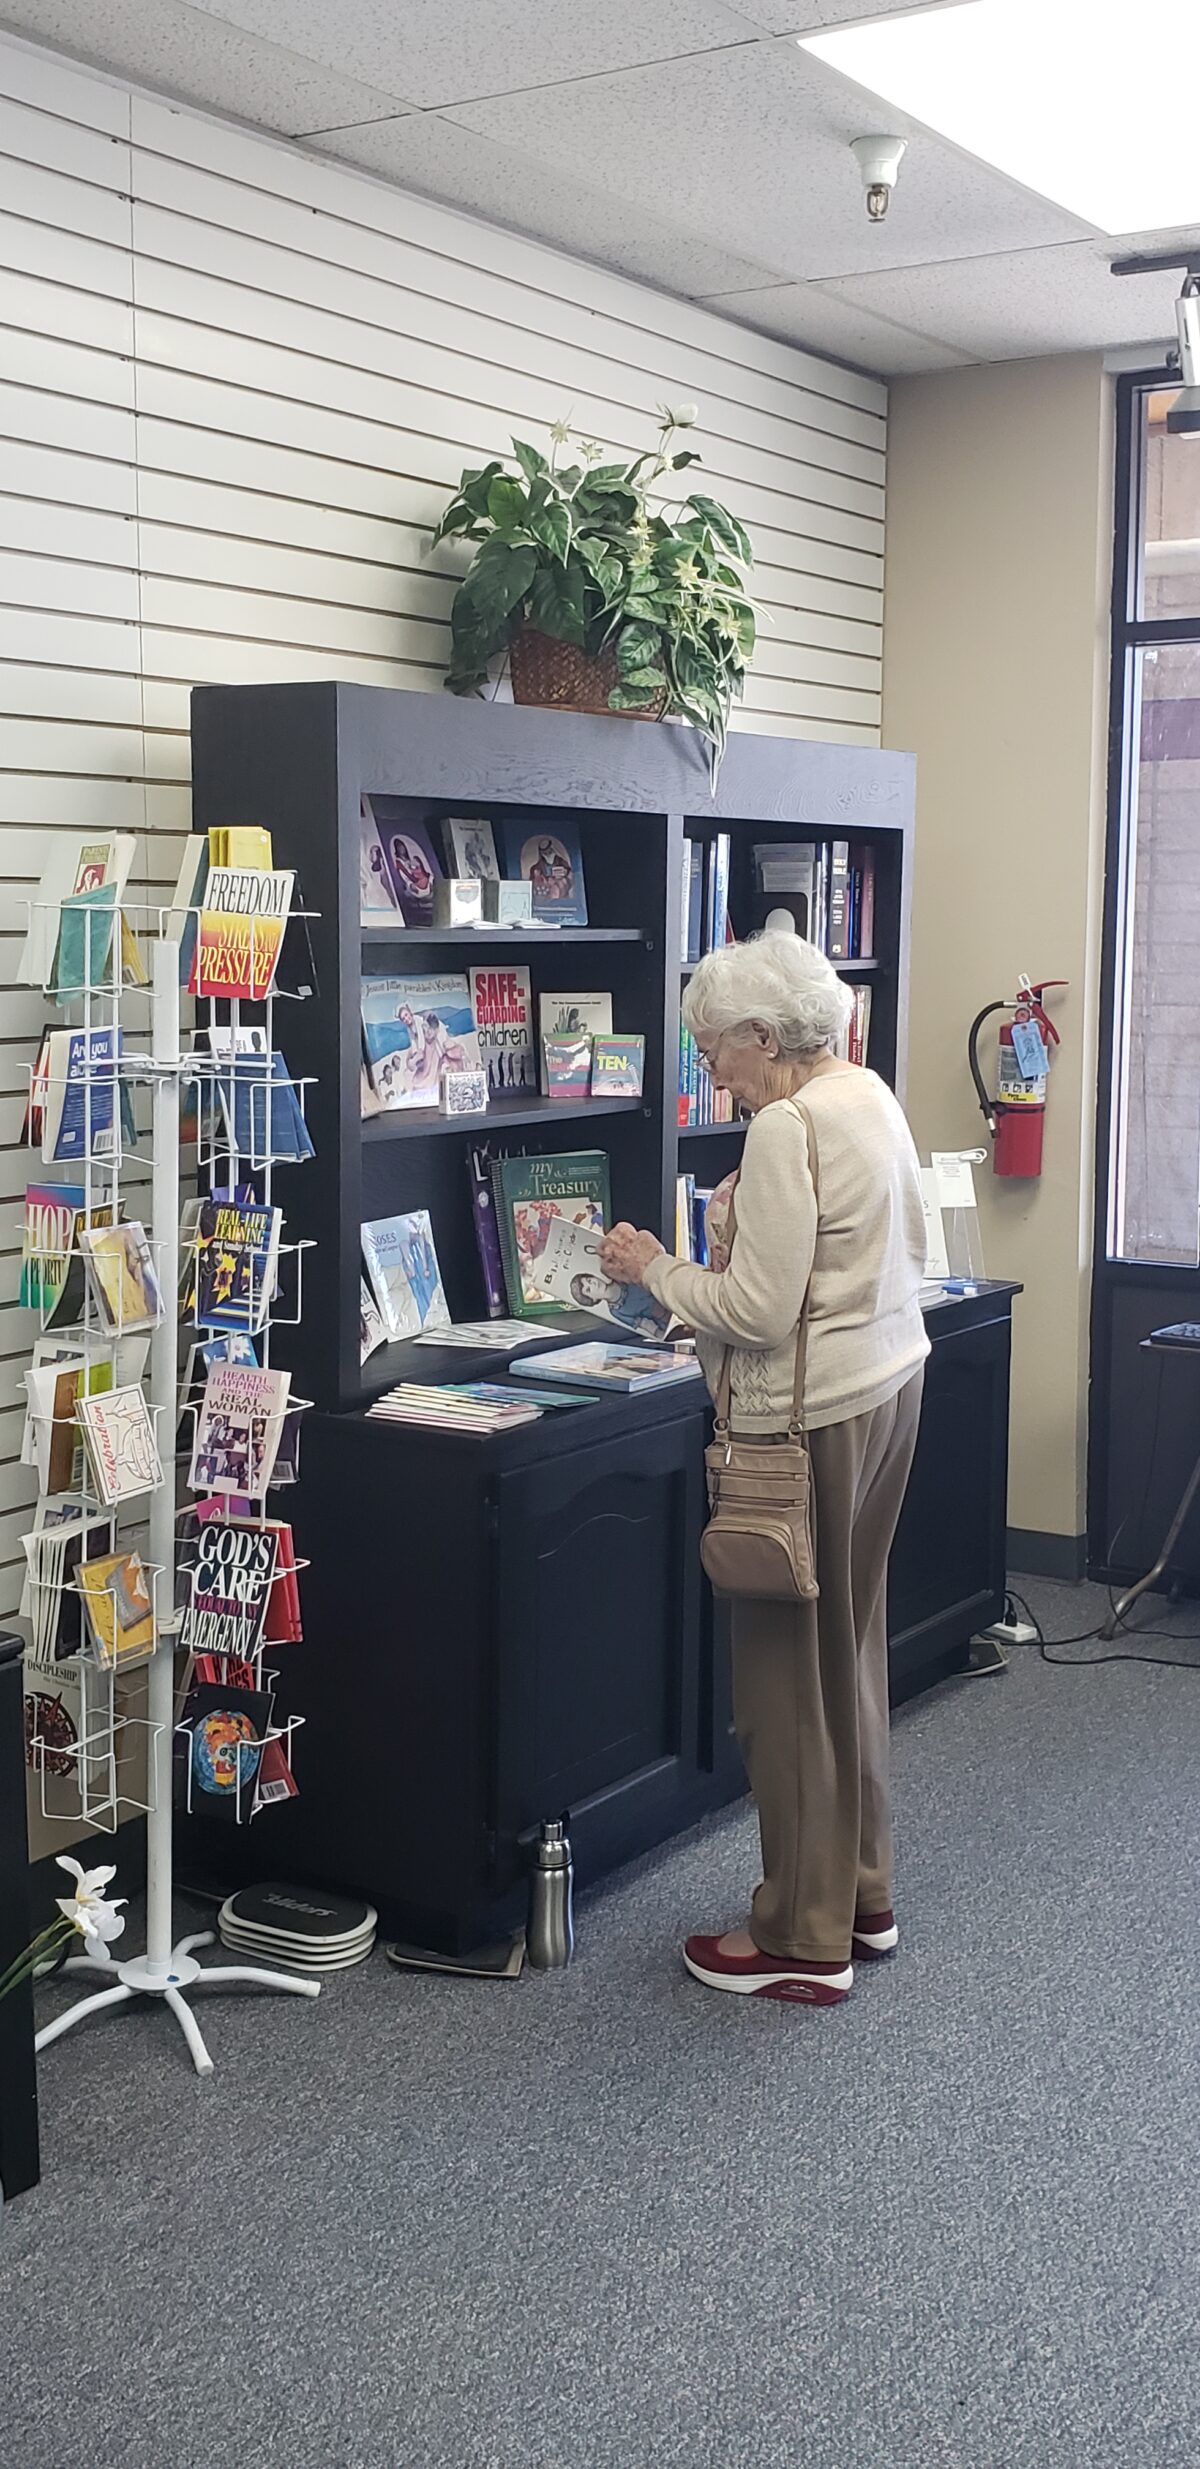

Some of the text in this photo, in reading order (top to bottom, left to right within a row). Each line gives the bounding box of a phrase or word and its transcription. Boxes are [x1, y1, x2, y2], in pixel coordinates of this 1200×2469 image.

[206, 873, 287, 918] FREEDOM
[218, 920, 265, 951] STRES
[194, 945, 273, 986] PRESSURE
[475, 973, 525, 1007] SAFE-
[477, 1004, 526, 1025] GUARDING
[477, 1022, 528, 1048] children
[72, 1041, 108, 1060] Ar you
[597, 1055, 627, 1071] TEN
[529, 1161, 553, 1182] my
[529, 1174, 602, 1197] Treasury
[217, 1208, 268, 1229] REAL-LIFE
[28, 1203, 74, 1261] HOP
[214, 1223, 265, 1245] LEARNING
[212, 1377, 276, 1394] HAPPINESS
[223, 1371, 267, 1385] HEALTH
[209, 1400, 272, 1417] WOMAN
[220, 1393, 262, 1408] REAL
[199, 1526, 272, 1572] GOD'S
[194, 1562, 265, 1605] CARE
[180, 1607, 256, 1657] EMERGENCY
[27, 1659, 78, 1682] DISCIPLESHIP
